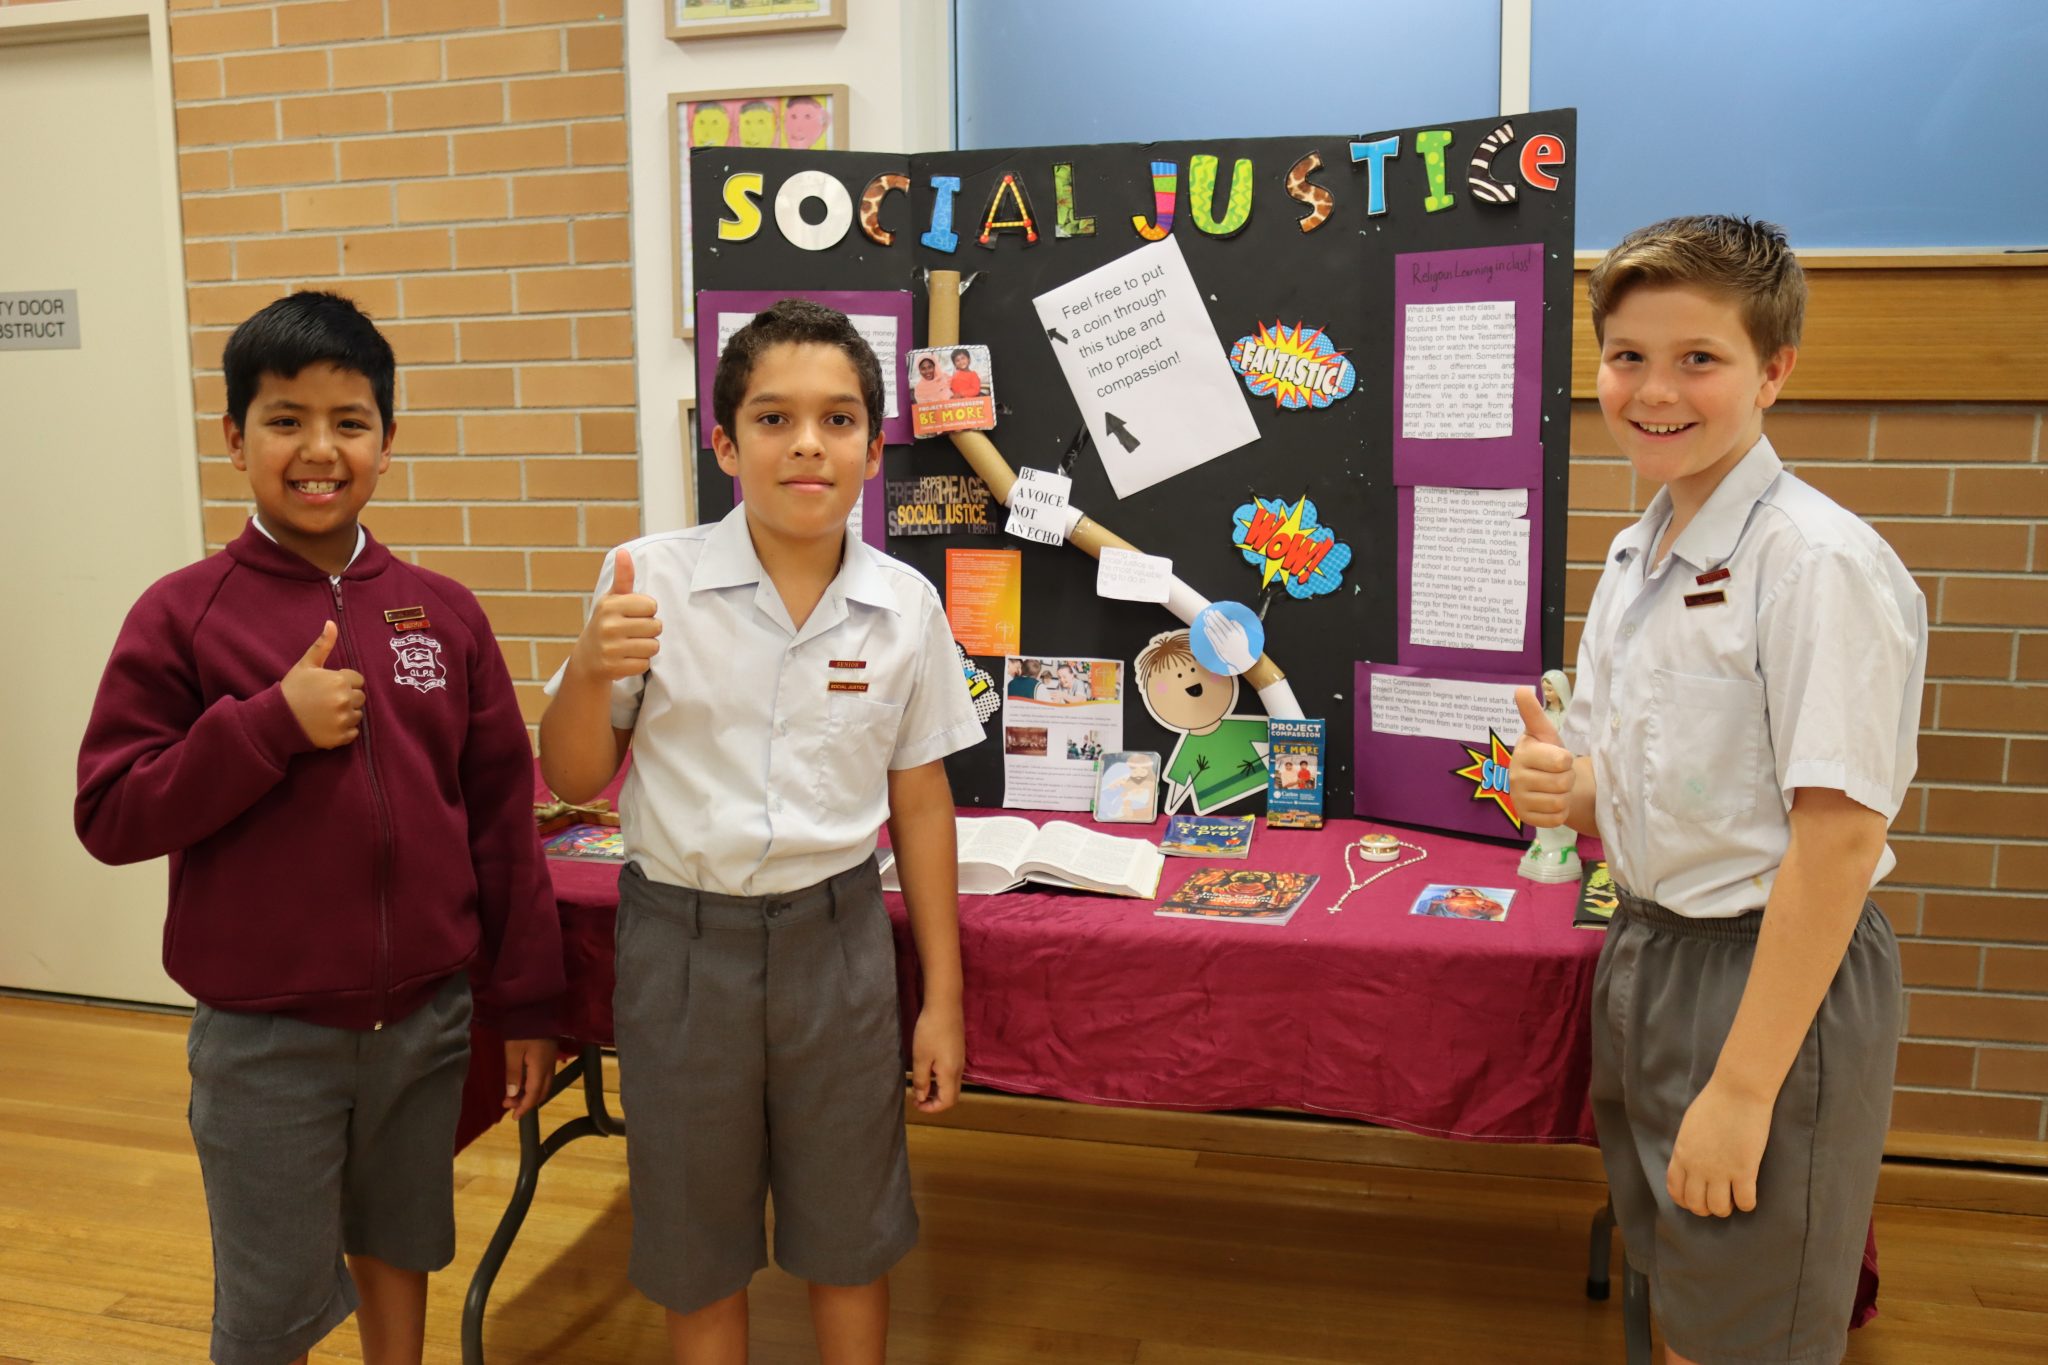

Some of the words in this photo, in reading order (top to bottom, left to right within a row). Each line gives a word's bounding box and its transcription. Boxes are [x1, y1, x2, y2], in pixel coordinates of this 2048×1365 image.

[717, 161, 1097, 254] SOCIAL
[1495, 262, 1505, 271] in
[1062, 297, 1093, 320] Feel
[1095, 286, 1122, 306] free
[1125, 278, 1138, 291] to
[1142, 264, 1165, 287] put
[19, 299, 64, 315] DOOR
[1071, 328, 1081, 339] a
[1084, 313, 1112, 334] coin
[1114, 288, 1167, 315] through
[1079, 341, 1104, 358] this
[1109, 324, 1136, 345] tube
[1141, 310, 1166, 331] and
[1087, 358, 1113, 379] into
[1116, 336, 1162, 367] project
[1240, 340, 1349, 396] FANTASTIC!
[1097, 351, 1181, 398] compassion!
[920, 412, 936, 425] BE
[942, 406, 985, 422] MORE
[1021, 467, 1037, 482] BE
[1016, 487, 1024, 498] A
[1028, 488, 1065, 508] VOICE
[897, 504, 941, 525] SOCIAL
[943, 503, 988, 525] JUSTICE
[1012, 503, 1038, 520] NOT
[1008, 522, 1026, 535] AN
[1243, 508, 1334, 585] WOW!
[1271, 723, 1322, 733] PROJECT
[1273, 744, 1286, 754] BE
[1290, 746, 1319, 755] MORE
[1176, 822, 1247, 831] Prayers
